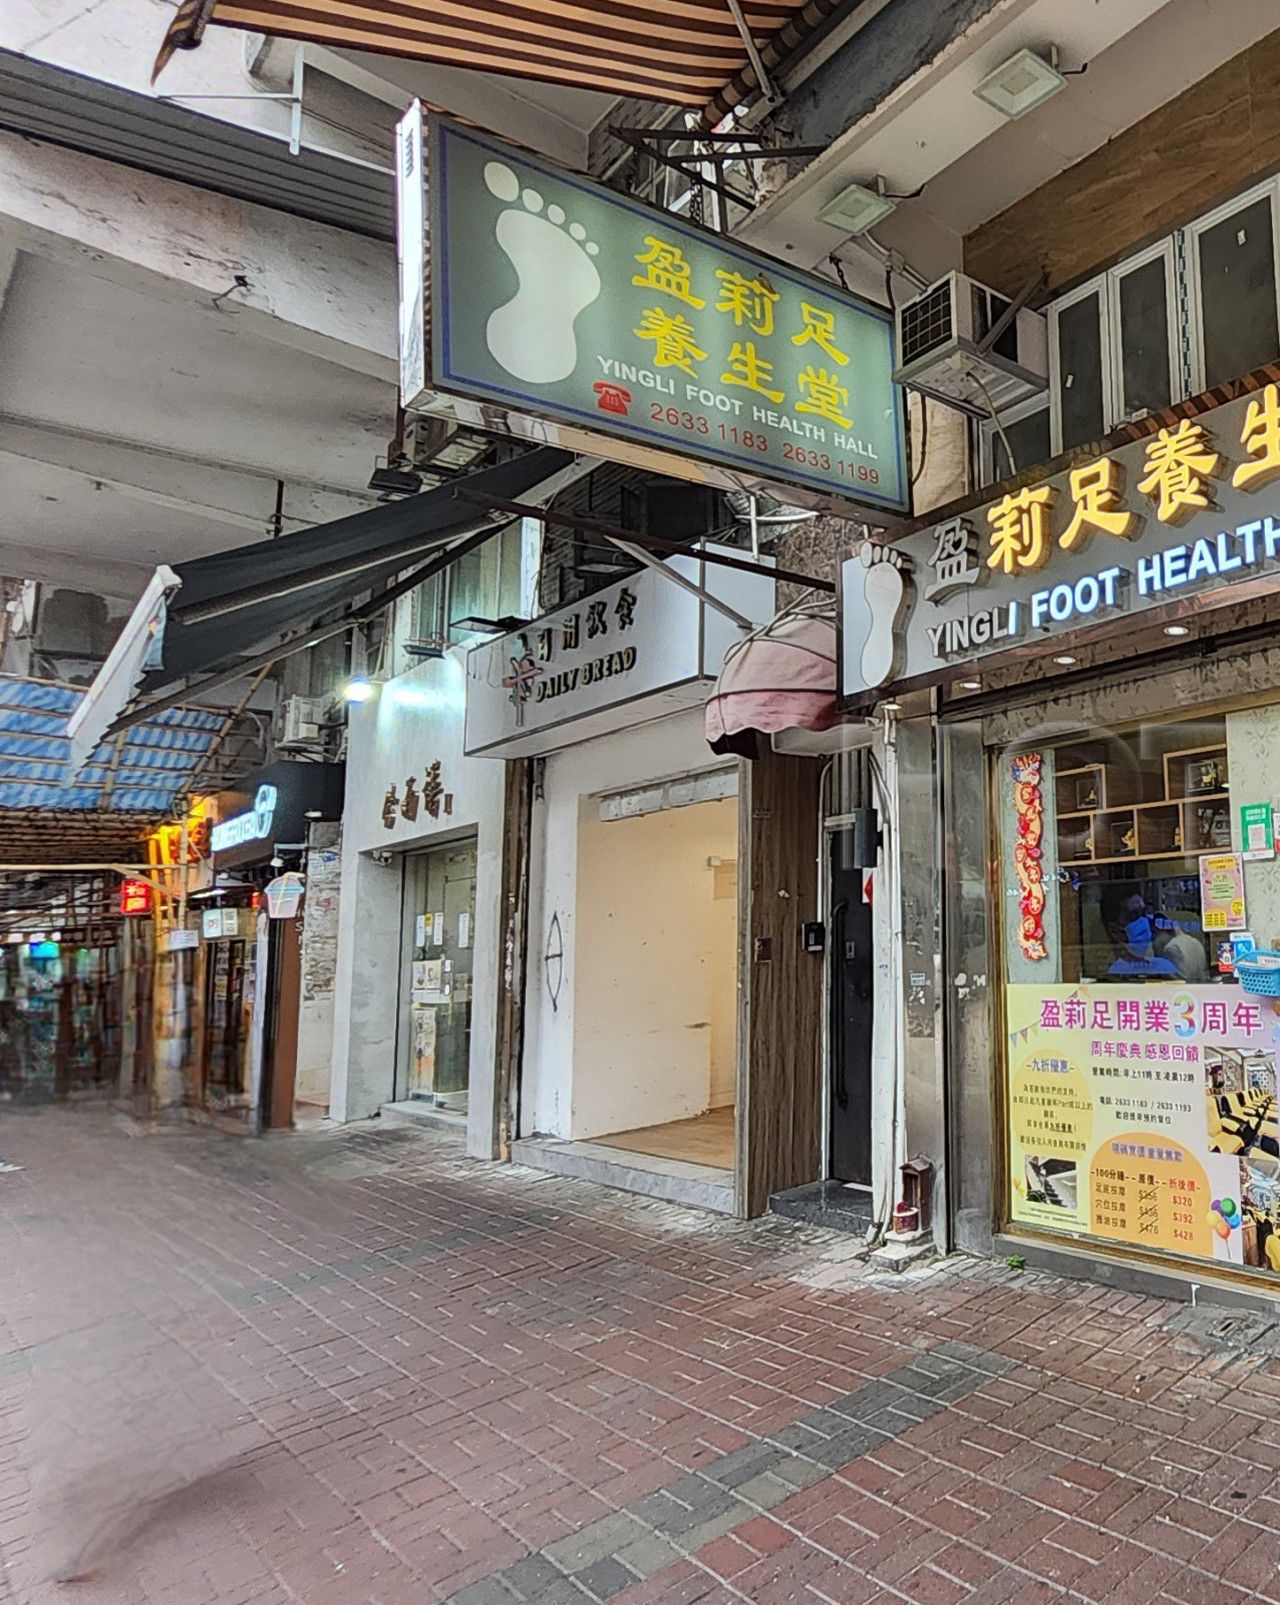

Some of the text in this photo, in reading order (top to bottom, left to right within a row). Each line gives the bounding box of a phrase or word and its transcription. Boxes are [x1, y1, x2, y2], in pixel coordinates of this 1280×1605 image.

[632, 237, 850, 366] 盈莉足
[597, 356, 879, 459] YINGLI FOOT HEALTH HALL
[634, 309, 853, 430] 養生堂
[650, 403, 879, 485] 2633 1183 2633 1199
[926, 600, 1017, 659] YINGLI
[1031, 567, 1121, 627] FOOT
[536, 646, 637, 703] DAILY BREAD
[1040, 990, 1263, 1037] 盈莉足開業3周年
